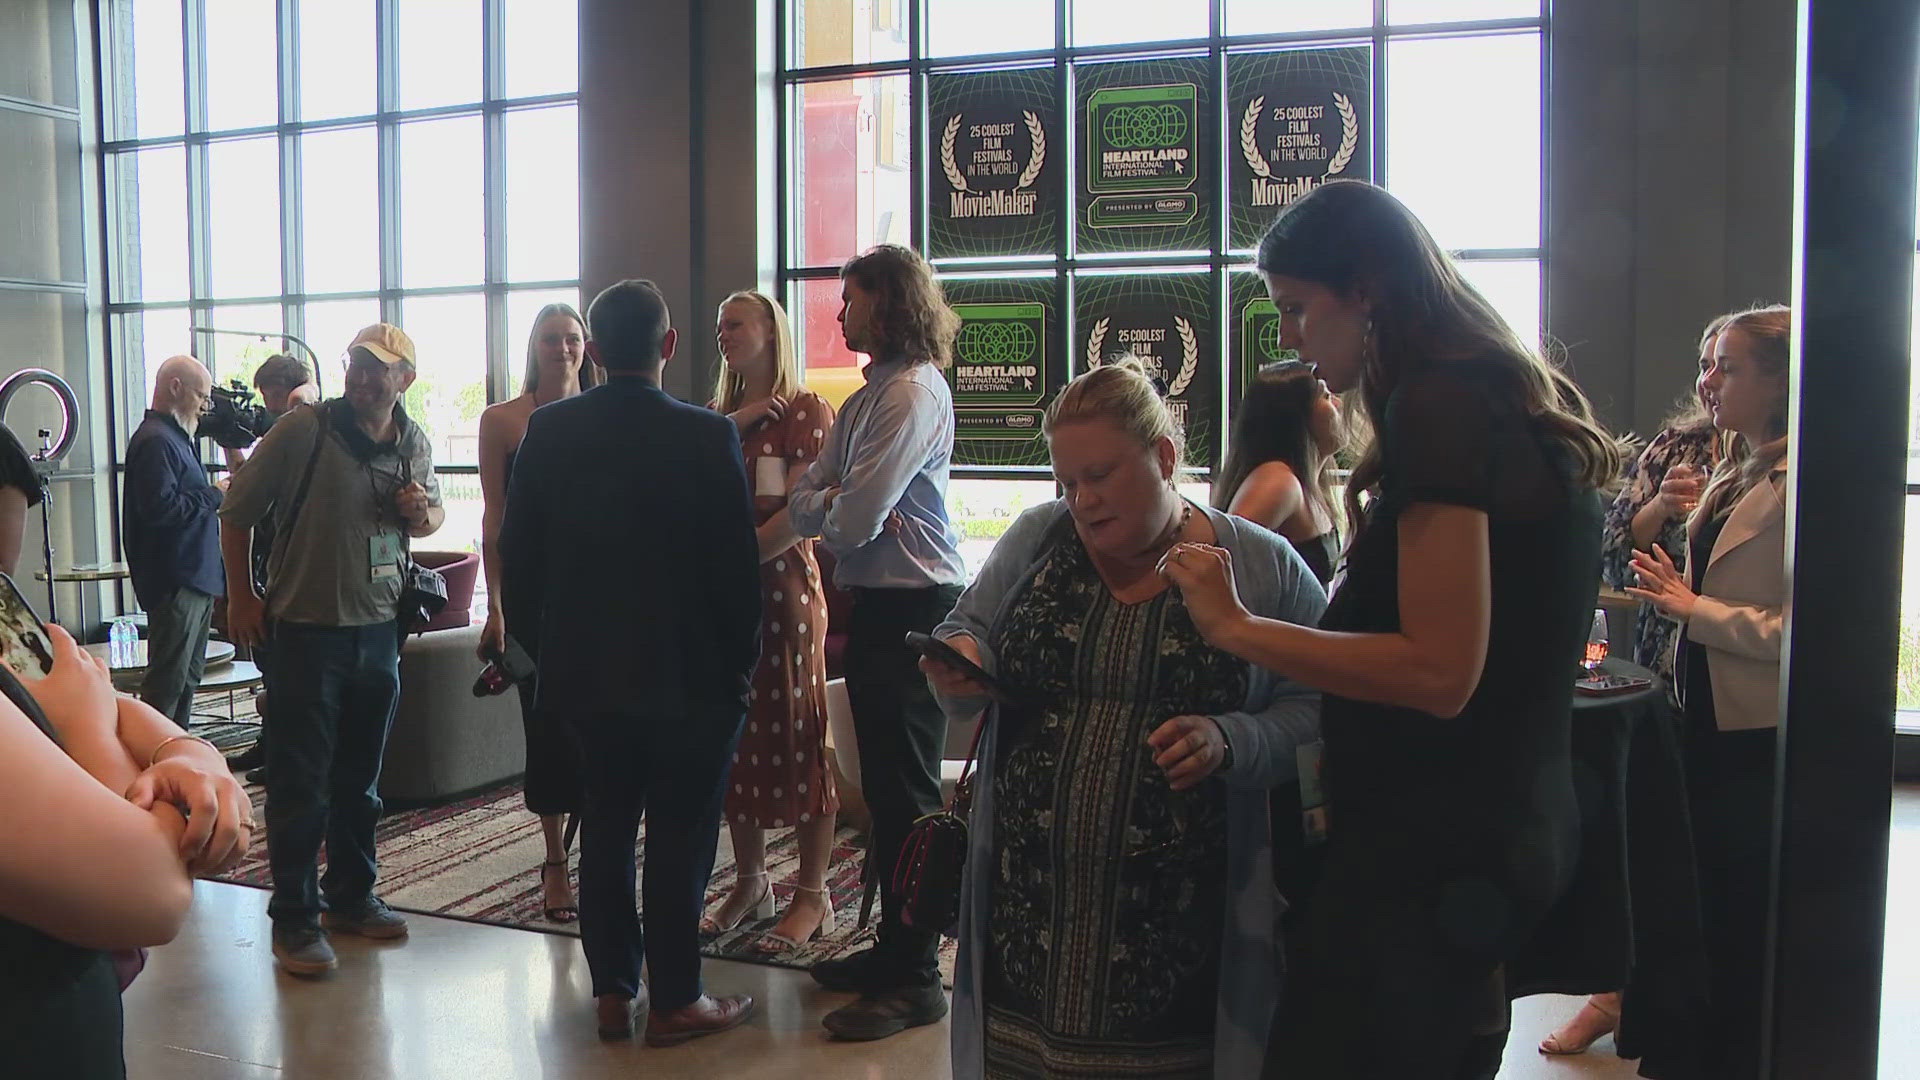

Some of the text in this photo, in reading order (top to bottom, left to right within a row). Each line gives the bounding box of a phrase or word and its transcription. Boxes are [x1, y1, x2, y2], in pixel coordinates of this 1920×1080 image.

[1274, 106, 1324, 120] 25 COOLEST
[970, 123, 1015, 138] 25 COOLEST
[1288, 120, 1309, 133] FILM
[983, 137, 1002, 150] FILM
[1277, 134, 1321, 148] FESTIVALS
[973, 149, 1013, 163] FESTIVALS
[1102, 148, 1188, 163] HEARTLAND
[1270, 147, 1328, 162] IN THE WORLD
[967, 162, 1018, 176] IN THE WORLD
[1102, 161, 1164, 171] INTERNATIONAL
[1102, 170, 1121, 178] FILM
[1122, 169, 1159, 177] FESTIVAL
[1251, 175, 1327, 206] MovieM
[950, 188, 1037, 218] MovieMaker
[1118, 329, 1166, 342] 25 COOLEST
[1132, 343, 1152, 355] FILM
[956, 365, 1037, 377] HEARTLAND
[956, 377, 1015, 385] INTERNATIONAL
